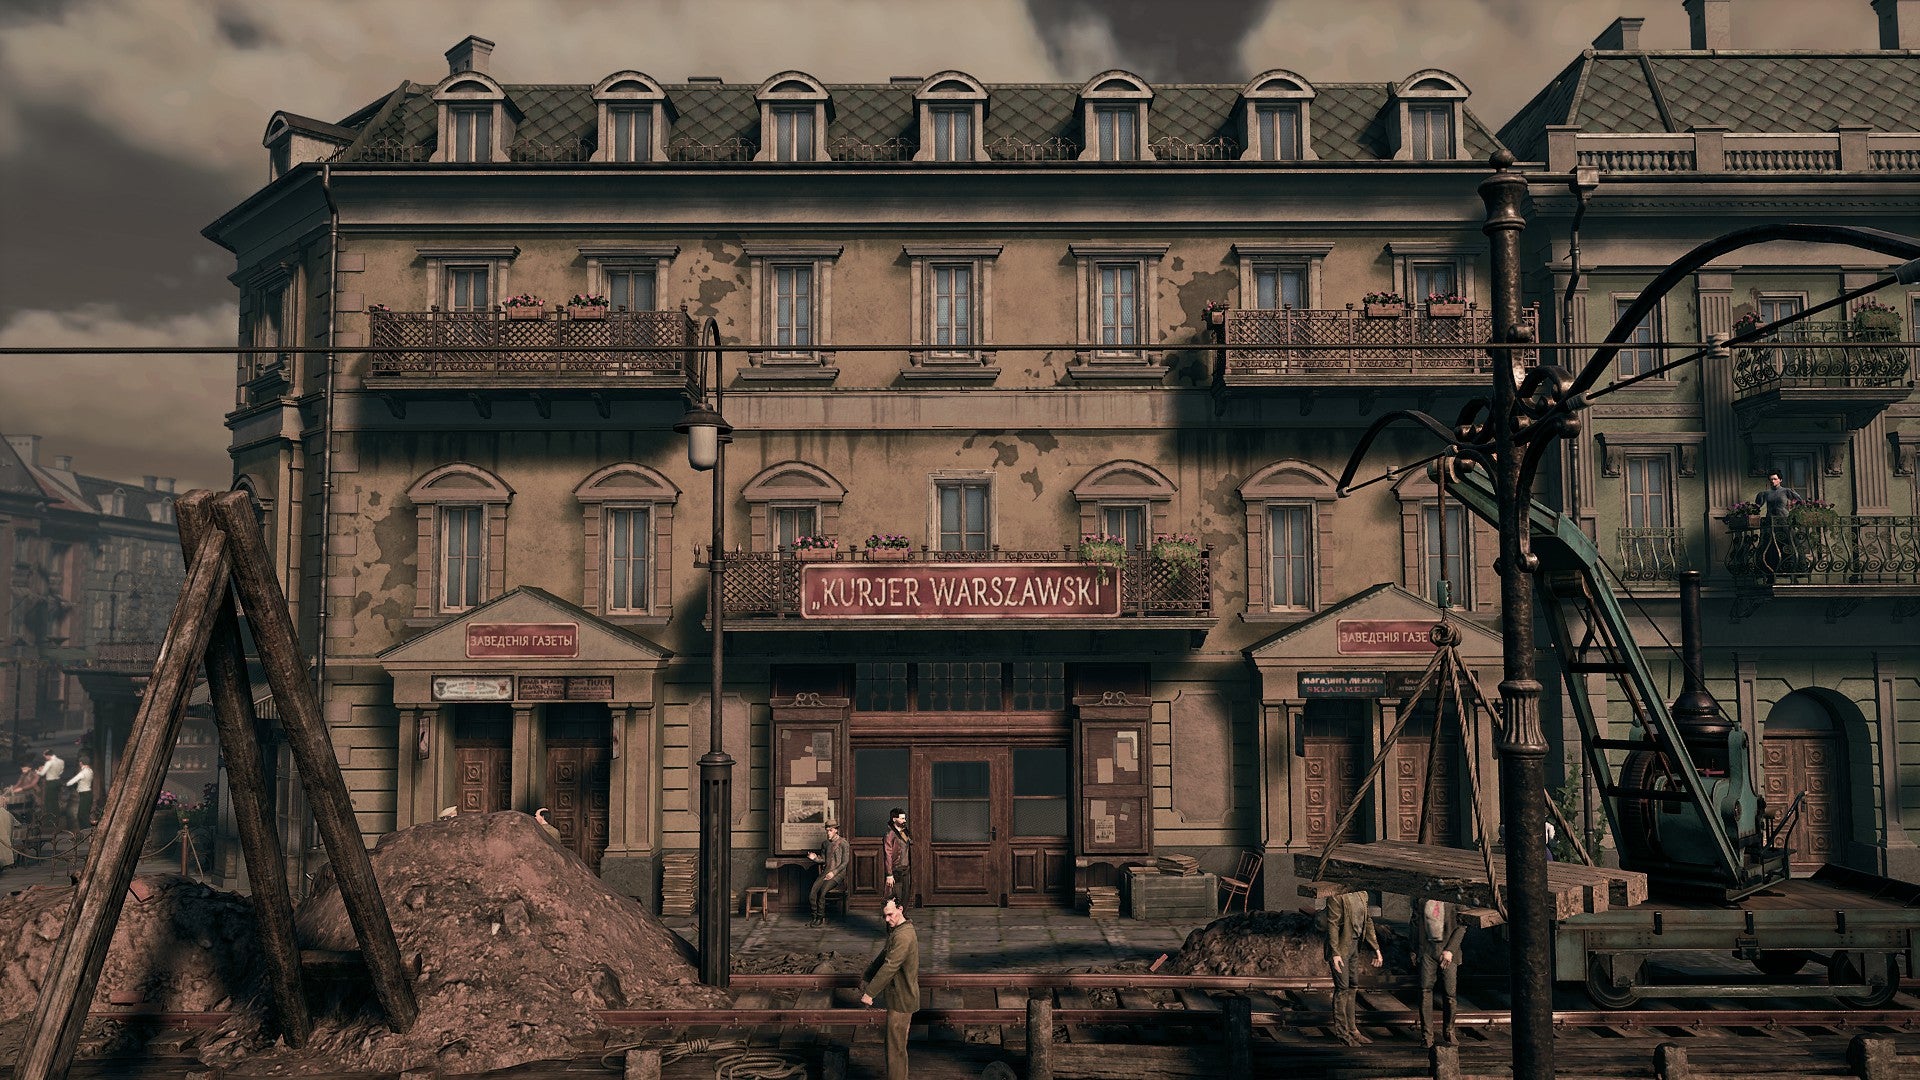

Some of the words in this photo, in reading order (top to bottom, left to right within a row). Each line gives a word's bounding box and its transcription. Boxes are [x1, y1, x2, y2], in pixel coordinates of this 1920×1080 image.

[470, 635, 529, 648] ЗАВЕДЕНІЯ
[532, 635, 573, 646] ГАЗЕТЫ
[1341, 631, 1400, 645] ЗАВЕДЕНІЯ
[1403, 631, 1430, 643] ГАЗЕ
